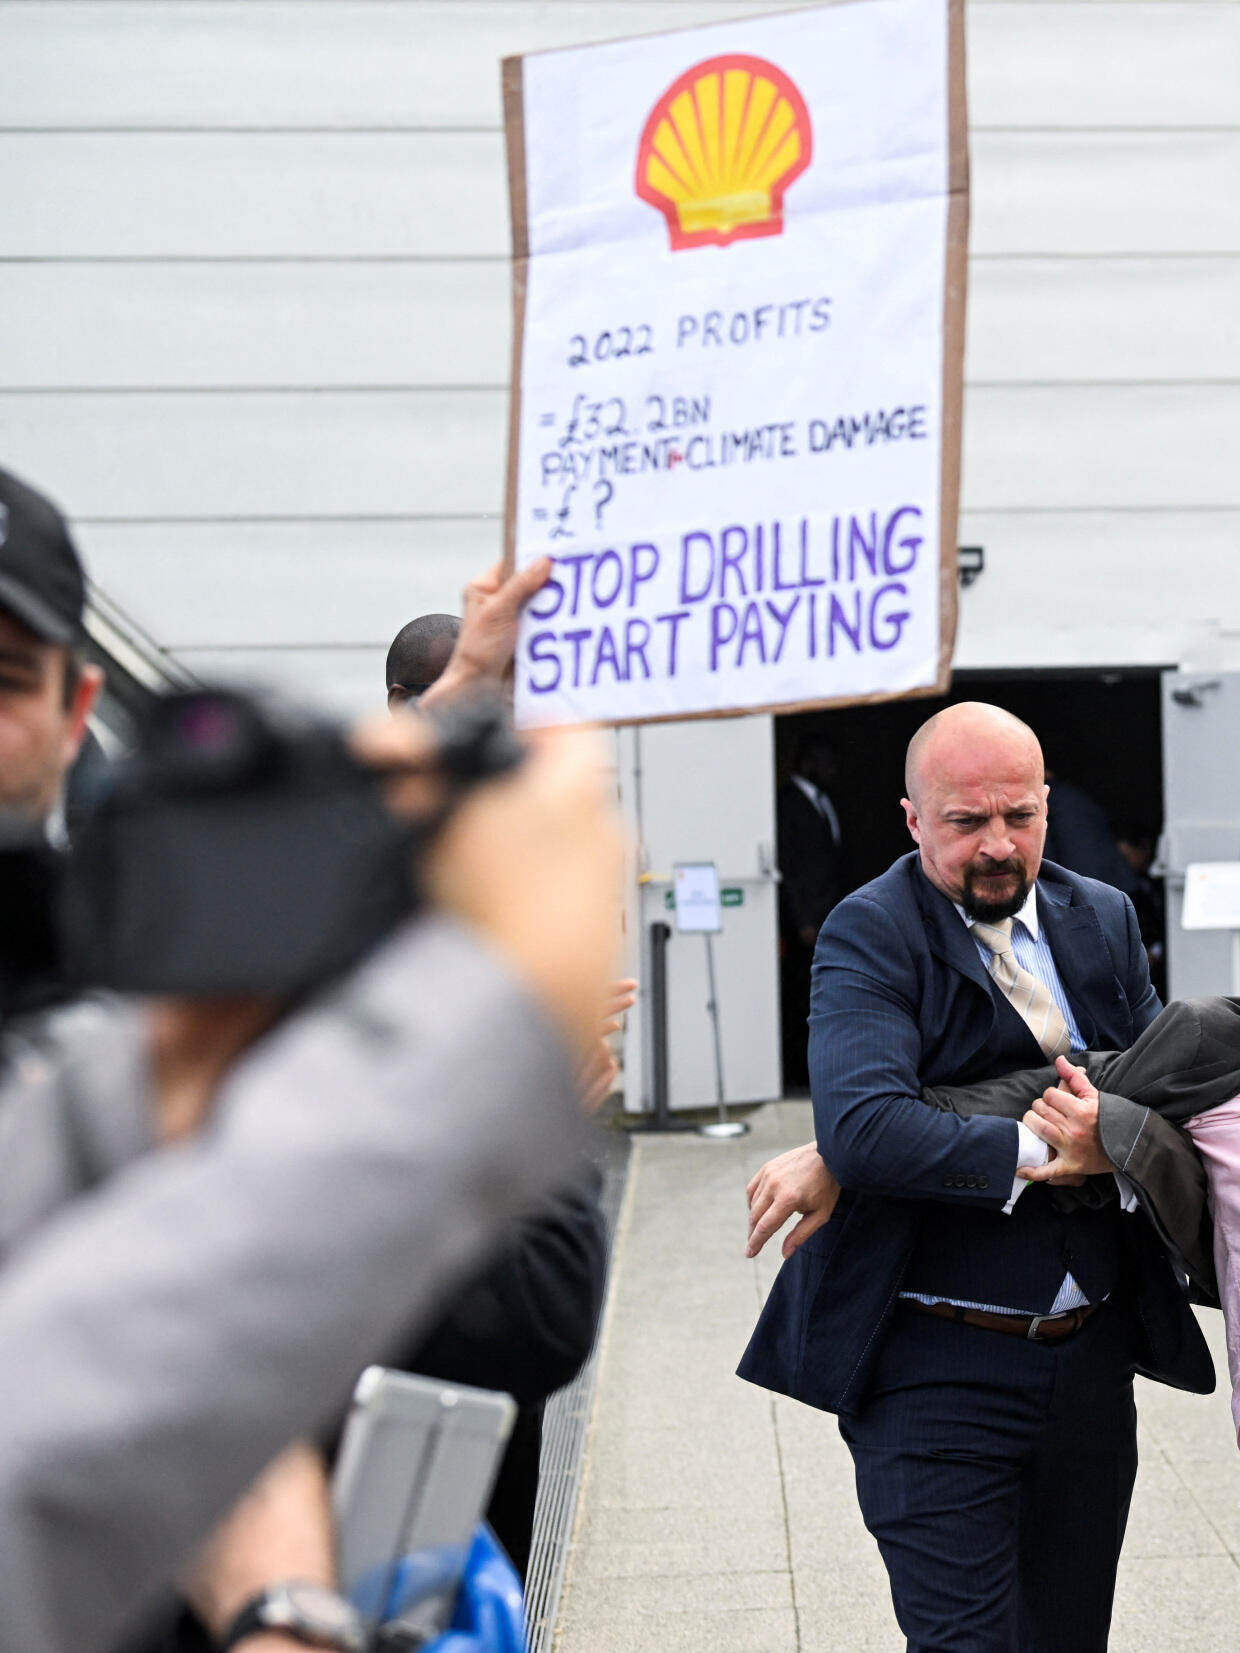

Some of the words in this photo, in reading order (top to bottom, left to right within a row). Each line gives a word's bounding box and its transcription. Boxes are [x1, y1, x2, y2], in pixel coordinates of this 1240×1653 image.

[567, 324, 654, 368] 2022
[676, 297, 832, 348] PROFITS
[541, 436, 680, 487] PAYMENT
[685, 420, 796, 471] CLIMATE
[808, 405, 928, 454] DAMAGE
[529, 541, 660, 621] STOP
[680, 505, 923, 606] DRILLING
[528, 611, 691, 695] START
[709, 582, 911, 672] PAYING
